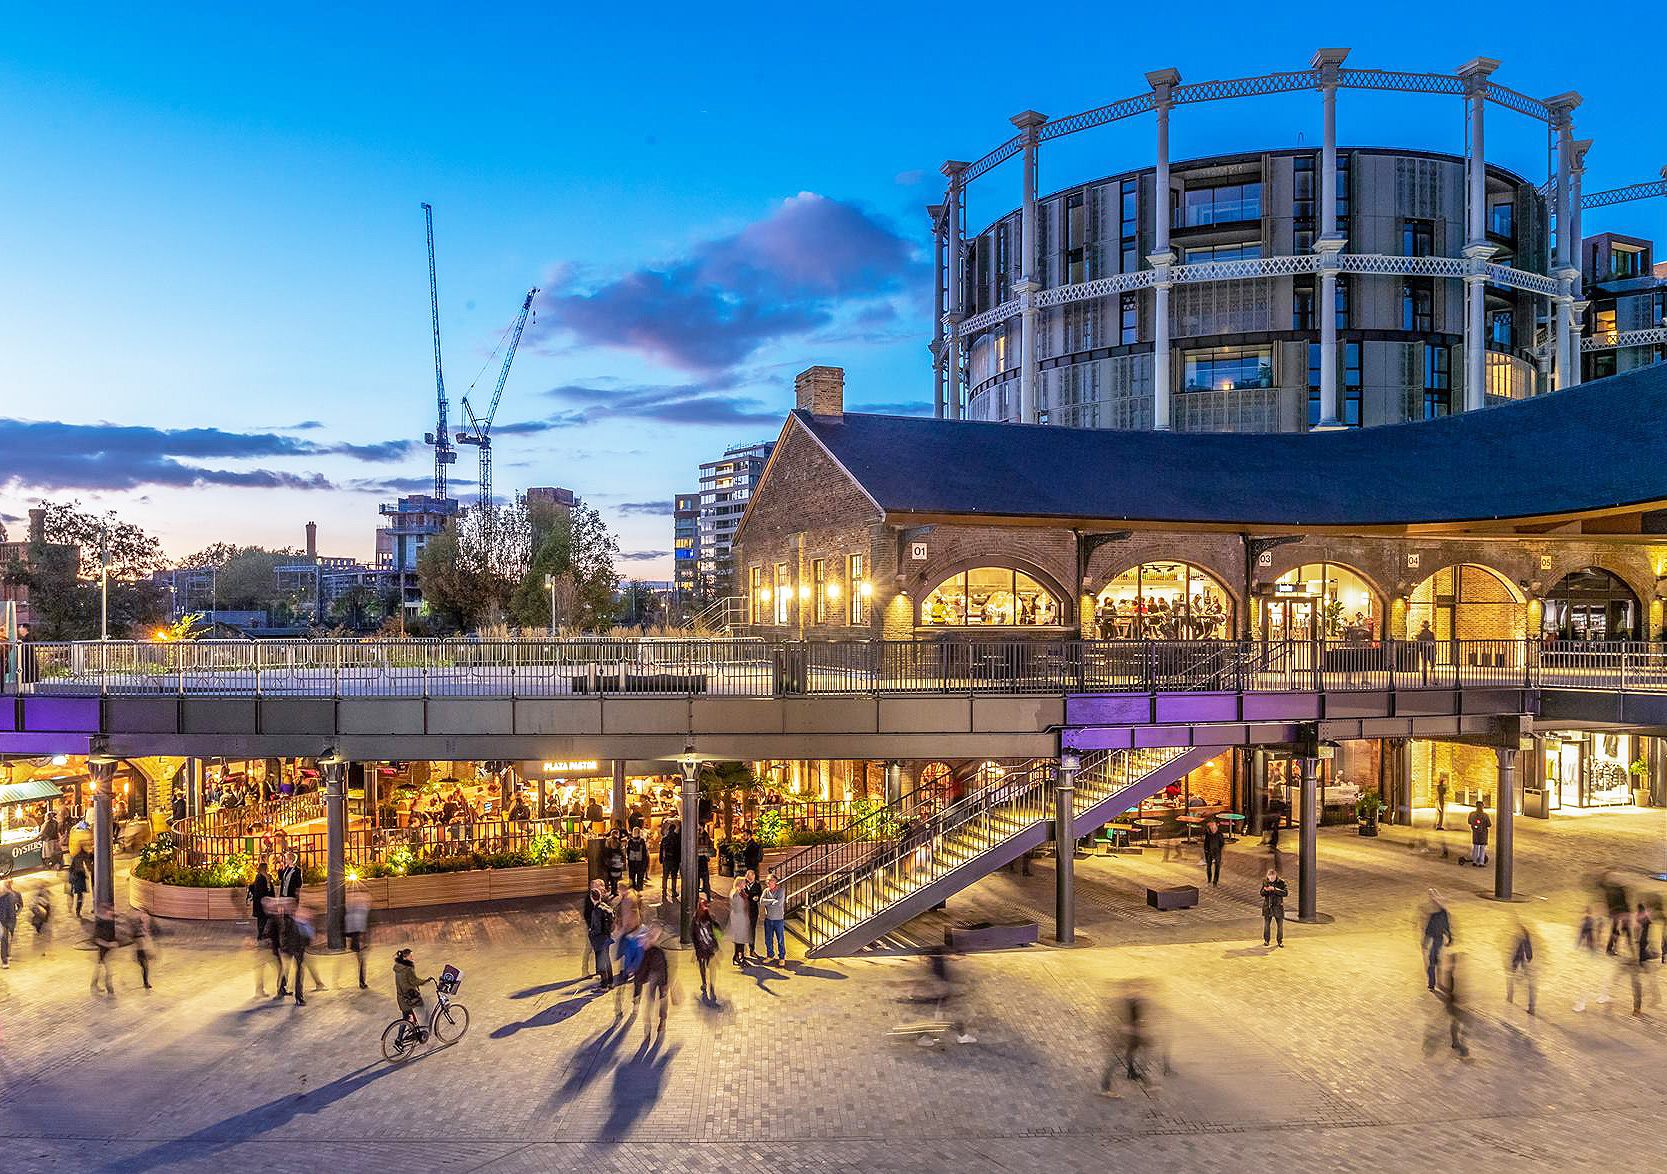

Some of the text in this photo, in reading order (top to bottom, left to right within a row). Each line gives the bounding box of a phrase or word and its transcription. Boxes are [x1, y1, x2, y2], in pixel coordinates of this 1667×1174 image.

[914, 547, 925, 556] 01
[1260, 555, 1271, 564] 03
[1408, 556, 1418, 565] 04
[1541, 558, 1551, 566] 05
[544, 762, 568, 771] PLAZA
[12, 841, 42, 858] OYSTERS
